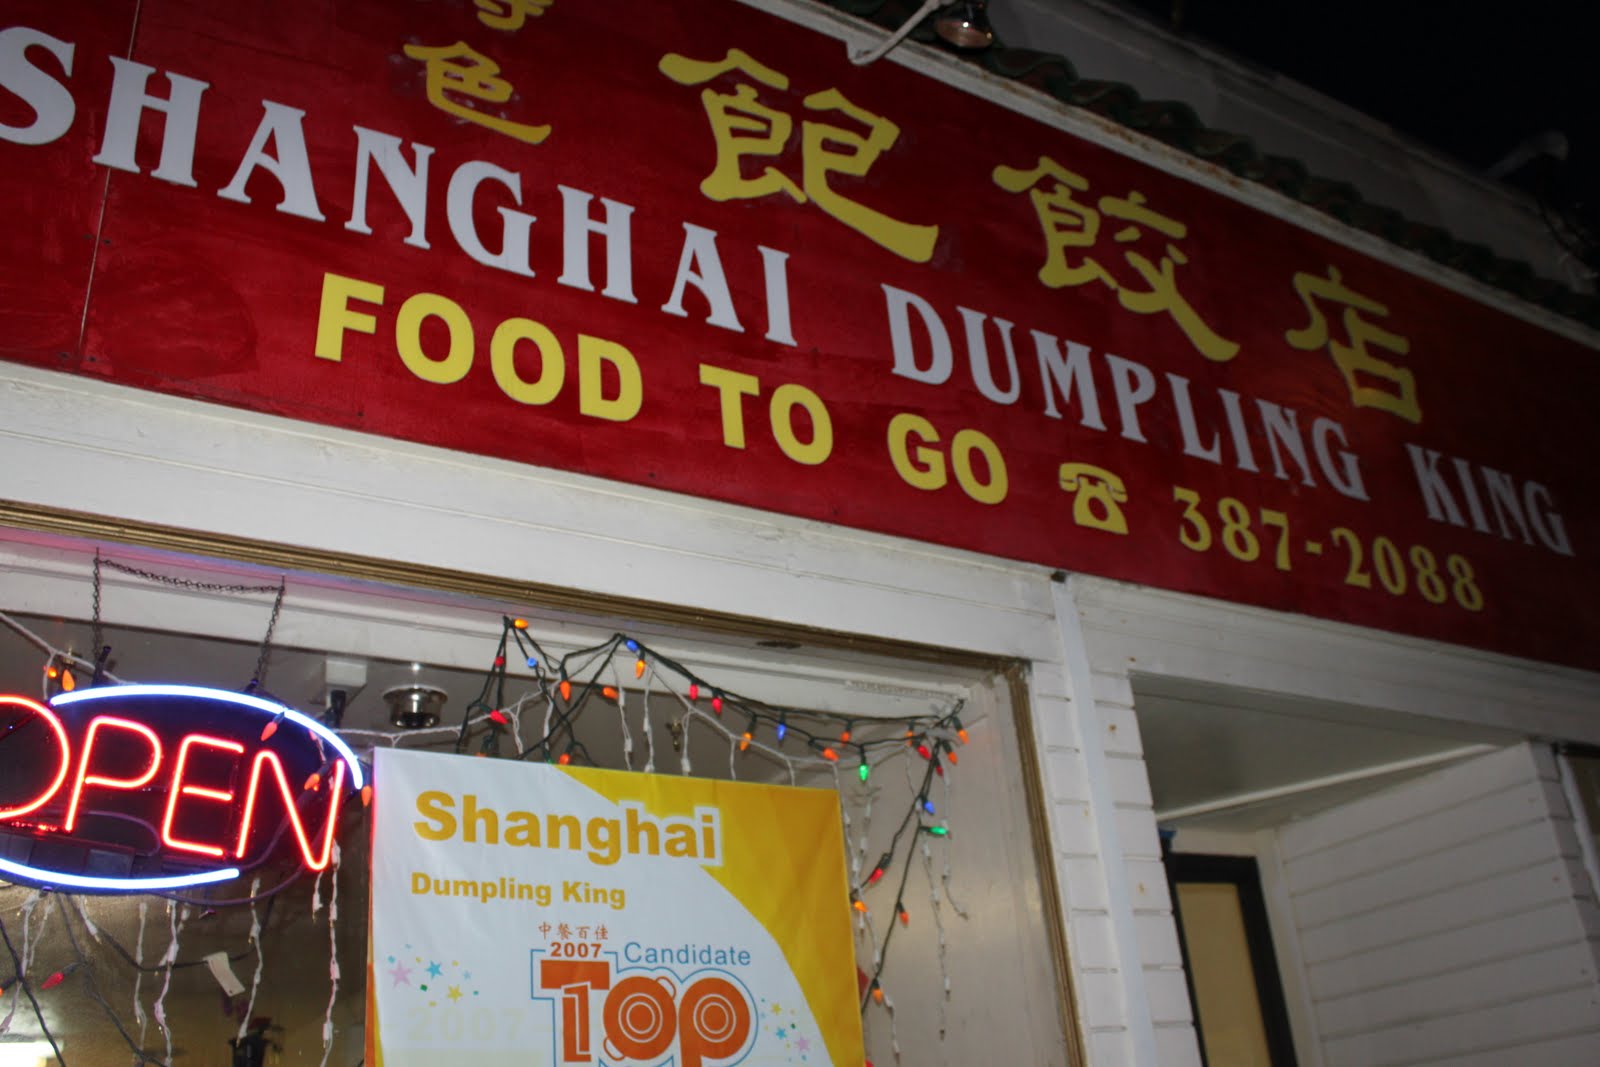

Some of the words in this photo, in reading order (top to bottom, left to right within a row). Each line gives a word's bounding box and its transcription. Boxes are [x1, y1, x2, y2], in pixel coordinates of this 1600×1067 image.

[0, 26, 797, 347] SHANGHAI
[881, 283, 1370, 501] DUMPLING
[1405, 442, 1575, 557] KING
[315, 272, 643, 422] FOOD
[699, 363, 834, 465] TO
[887, 413, 1009, 505] GO
[1173, 486, 1484, 612] 387-2088
[413, 790, 719, 866] Shanghai
[411, 872, 552, 907] Dumpling
[562, 880, 626, 911] King
[538, 921, 609, 941] 中餐百佳
[550, 941, 602, 958] 2007
[624, 941, 751, 966] Candidate
[405, 1006, 528, 1041] 2007
